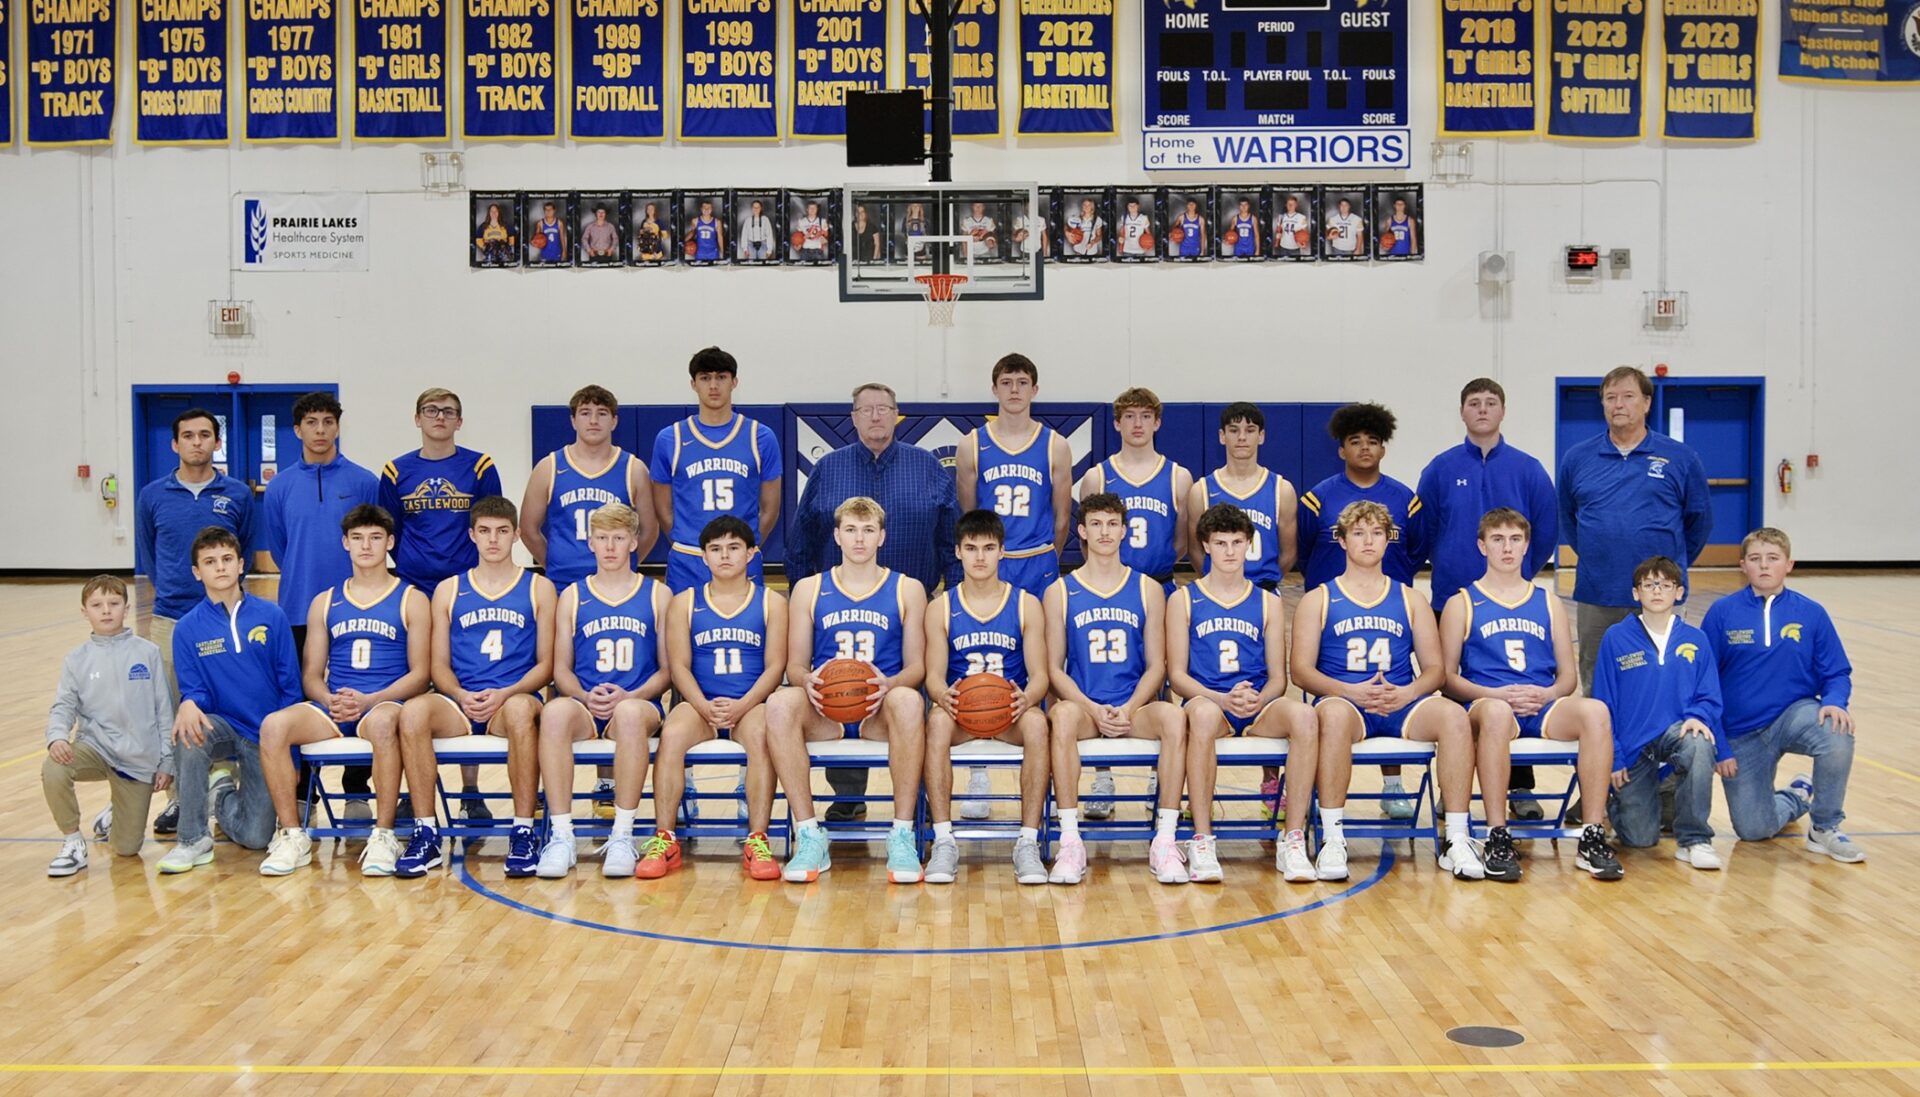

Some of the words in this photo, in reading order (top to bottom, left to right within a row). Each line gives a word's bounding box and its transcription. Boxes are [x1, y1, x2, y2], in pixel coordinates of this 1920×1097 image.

[33, 0, 109, 23] CHAMPS
[142, 0, 220, 21] CHAMPS
[250, 0, 330, 20] CHAMPS
[1165, 13, 1209, 29] HOME
[1340, 11, 1390, 28] GUEST
[1790, 8, 1838, 24] Ribbon
[1841, 9, 1889, 26] School
[269, 26, 314, 51] 1977
[379, 25, 421, 49] 1981
[487, 23, 532, 48] 1982
[596, 24, 640, 49] 1989
[707, 21, 753, 45] 1999
[817, 17, 861, 42] 2001
[1040, 22, 1093, 46] 2012
[1258, 21, 1295, 33] PERIOD
[1461, 18, 1515, 43] 2018
[1567, 21, 1626, 47] 2023
[1682, 23, 1739, 48] 2023
[52, 30, 93, 54] 1971
[161, 28, 205, 52] 1975
[1799, 35, 1880, 53] Castlewood
[32, 60, 58, 84] "B"
[65, 58, 111, 84] BOYS
[139, 59, 167, 83] "B"
[173, 57, 221, 82] BOYS
[248, 56, 276, 80] "B"
[282, 55, 331, 80] BOYS
[359, 55, 384, 80] "B"
[389, 54, 440, 80] GIRLS
[468, 54, 495, 78] "B"
[501, 52, 551, 78] BOYS
[593, 53, 640, 78] "9B"
[687, 52, 714, 75] "B"
[721, 51, 772, 76] BOYS
[799, 48, 826, 72] "B"
[832, 48, 883, 73] BOYS
[952, 52, 994, 78] IRLS
[1027, 52, 1053, 76] "B"
[1056, 52, 1105, 76] BOYS
[1447, 50, 1473, 74] "B"
[1476, 50, 1531, 75] GIRLS
[1555, 52, 1581, 78] "B"
[1584, 54, 1639, 80] GIRLS
[1667, 53, 1696, 80] "B"
[1697, 53, 1753, 81] GIRLS
[1800, 52, 1830, 69] High
[1832, 54, 1880, 71] School
[1157, 70, 1190, 82] FOULS
[1202, 70, 1231, 81] T.O.L.
[1243, 70, 1283, 81] PLAYER
[1285, 69, 1311, 81] FOUL
[1323, 69, 1351, 80] T.O.L.
[1362, 69, 1396, 80] FOULS
[41, 91, 102, 116] TRACK
[141, 91, 176, 115] CROSS
[177, 90, 222, 114] COUNTRY
[250, 89, 284, 113] CROSS
[285, 88, 332, 112] COUNTRY
[359, 88, 441, 112] BASKETBALL
[477, 85, 544, 111] TRACK
[577, 86, 657, 111] FOOTBALL
[687, 84, 771, 108] BASKETBALL
[1024, 84, 1109, 109] BASKETBALL
[1444, 81, 1534, 109] BASKETBALL
[1562, 87, 1630, 113] SOFTBALL
[1667, 86, 1754, 114] BASKETBALL
[1157, 114, 1190, 126] SCORE
[1258, 114, 1294, 125] MATCH
[1362, 113, 1396, 125] SCORE
[1150, 137, 1195, 149] Home
[1213, 135, 1404, 163] WARRIORS
[1150, 153, 1166, 164] of
[1177, 153, 1202, 164] the
[273, 218, 319, 227] PRAIRIE
[322, 218, 357, 227] LAKES
[1130, 227, 1136, 238] 2
[1188, 229, 1193, 237] 3
[1285, 224, 1295, 233] 44
[1339, 226, 1348, 238] 21
[273, 231, 327, 243] Healthcare
[330, 231, 364, 245] System
[222, 308, 240, 322] EXIT
[1658, 300, 1675, 314] EXIT
[685, 457, 749, 479] WARRIORS
[983, 463, 1043, 485] WARRIORS
[403, 497, 471, 511] CASTLEWOOD
[702, 478, 734, 511] 15
[994, 484, 1031, 517] 32
[1120, 495, 1168, 517] RRIORS
[574, 508, 594, 541] 1
[1129, 517, 1148, 548] 3
[331, 618, 397, 640] WARRIORS
[459, 607, 525, 629] WARRIORS
[582, 615, 647, 638] WARRIORS
[822, 608, 889, 631] WARRIORS
[1073, 607, 1139, 628] WARRIORS
[1195, 617, 1259, 641] WARRIORS
[1333, 615, 1404, 637] WARRIORS
[1479, 617, 1546, 640] WARRIORS
[480, 629, 504, 662] 4
[694, 627, 761, 647] WARRIORS
[833, 628, 877, 663] 33
[953, 631, 1016, 651] WARRIORS
[1087, 628, 1127, 663] 23
[351, 638, 372, 669] 0
[595, 637, 634, 673] 30
[713, 647, 743, 675] 11
[1219, 639, 1240, 673] 2
[1345, 635, 1393, 673] 24
[1504, 639, 1527, 672] 5
